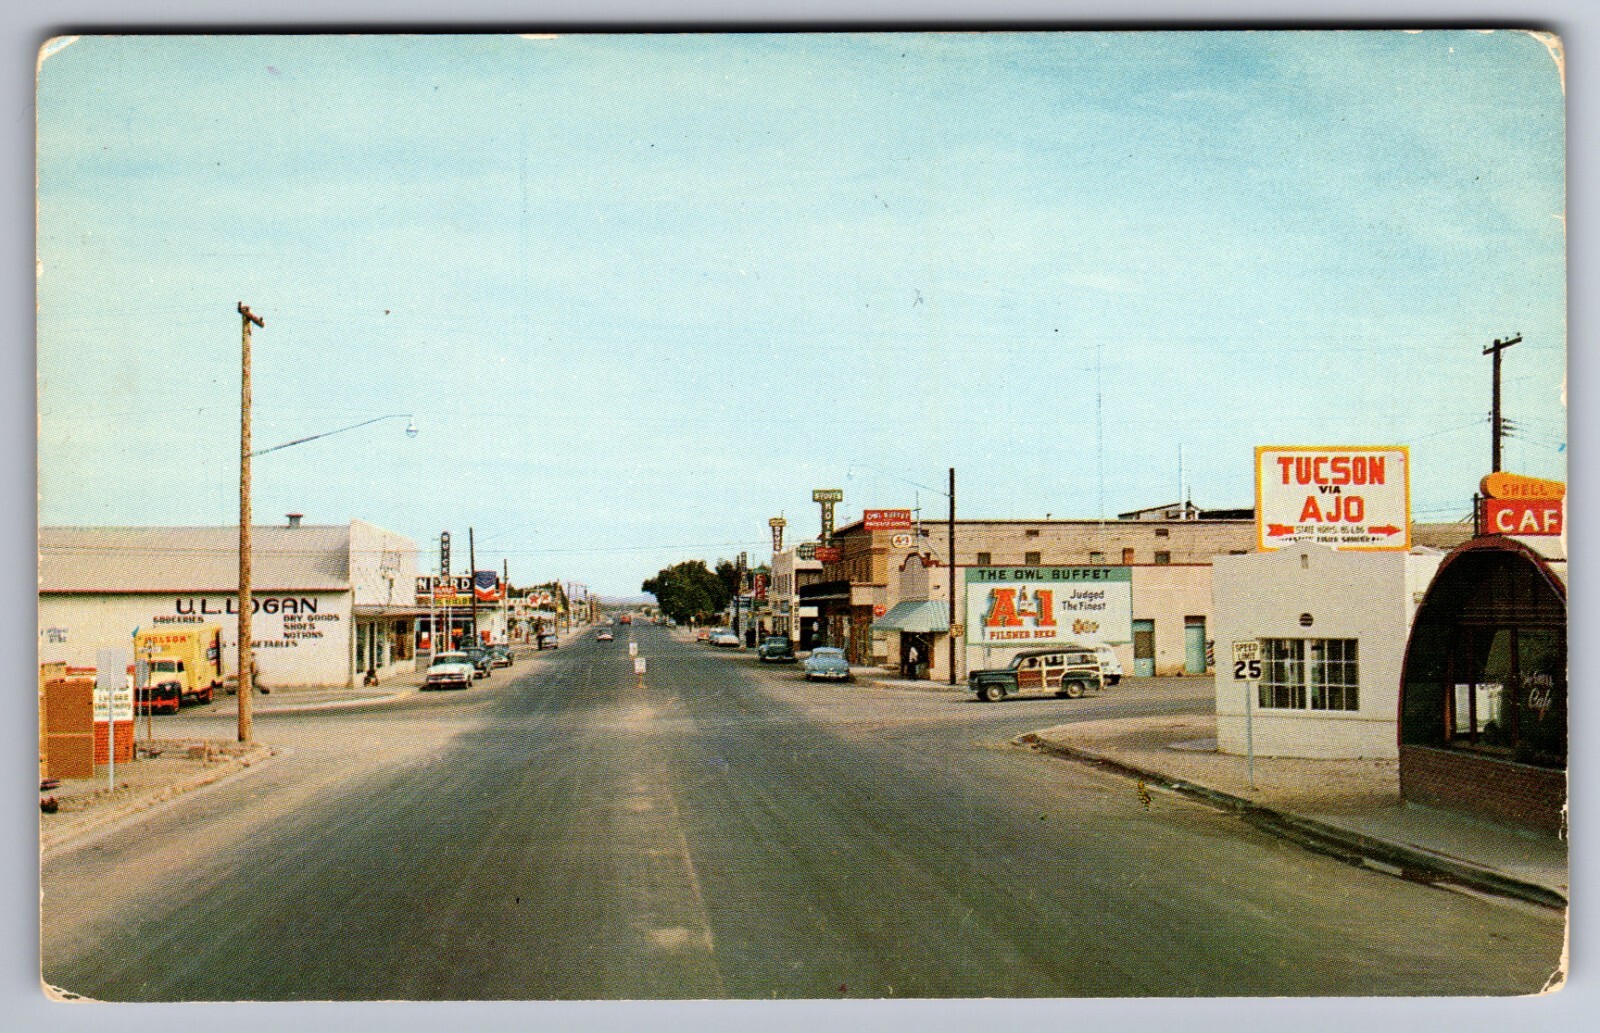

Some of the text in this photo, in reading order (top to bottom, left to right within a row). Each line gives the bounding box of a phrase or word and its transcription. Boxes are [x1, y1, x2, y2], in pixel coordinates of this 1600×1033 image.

[1277, 456, 1385, 485] TUCSON
[1318, 486, 1342, 494] VIA
[1502, 484, 1548, 496] SHELL
[1299, 495, 1365, 523] AJO
[1496, 508, 1558, 533] CAF
[978, 569, 1111, 580] THE OWL BUFFET
[1070, 589, 1105, 601] Judged
[1062, 601, 1106, 610] The Finest
[153, 615, 204, 623] GROCERIES
[307, 613, 340, 621] GOODS
[284, 622, 315, 630] SHOES
[284, 630, 323, 639] NOTIONS
[990, 630, 1057, 640] PILSNER BEER
[251, 640, 298, 648] GETABLES
[1234, 643, 1258, 651] SPEED
[1238, 651, 1256, 660] LIMIT
[1234, 660, 1261, 679] 25
